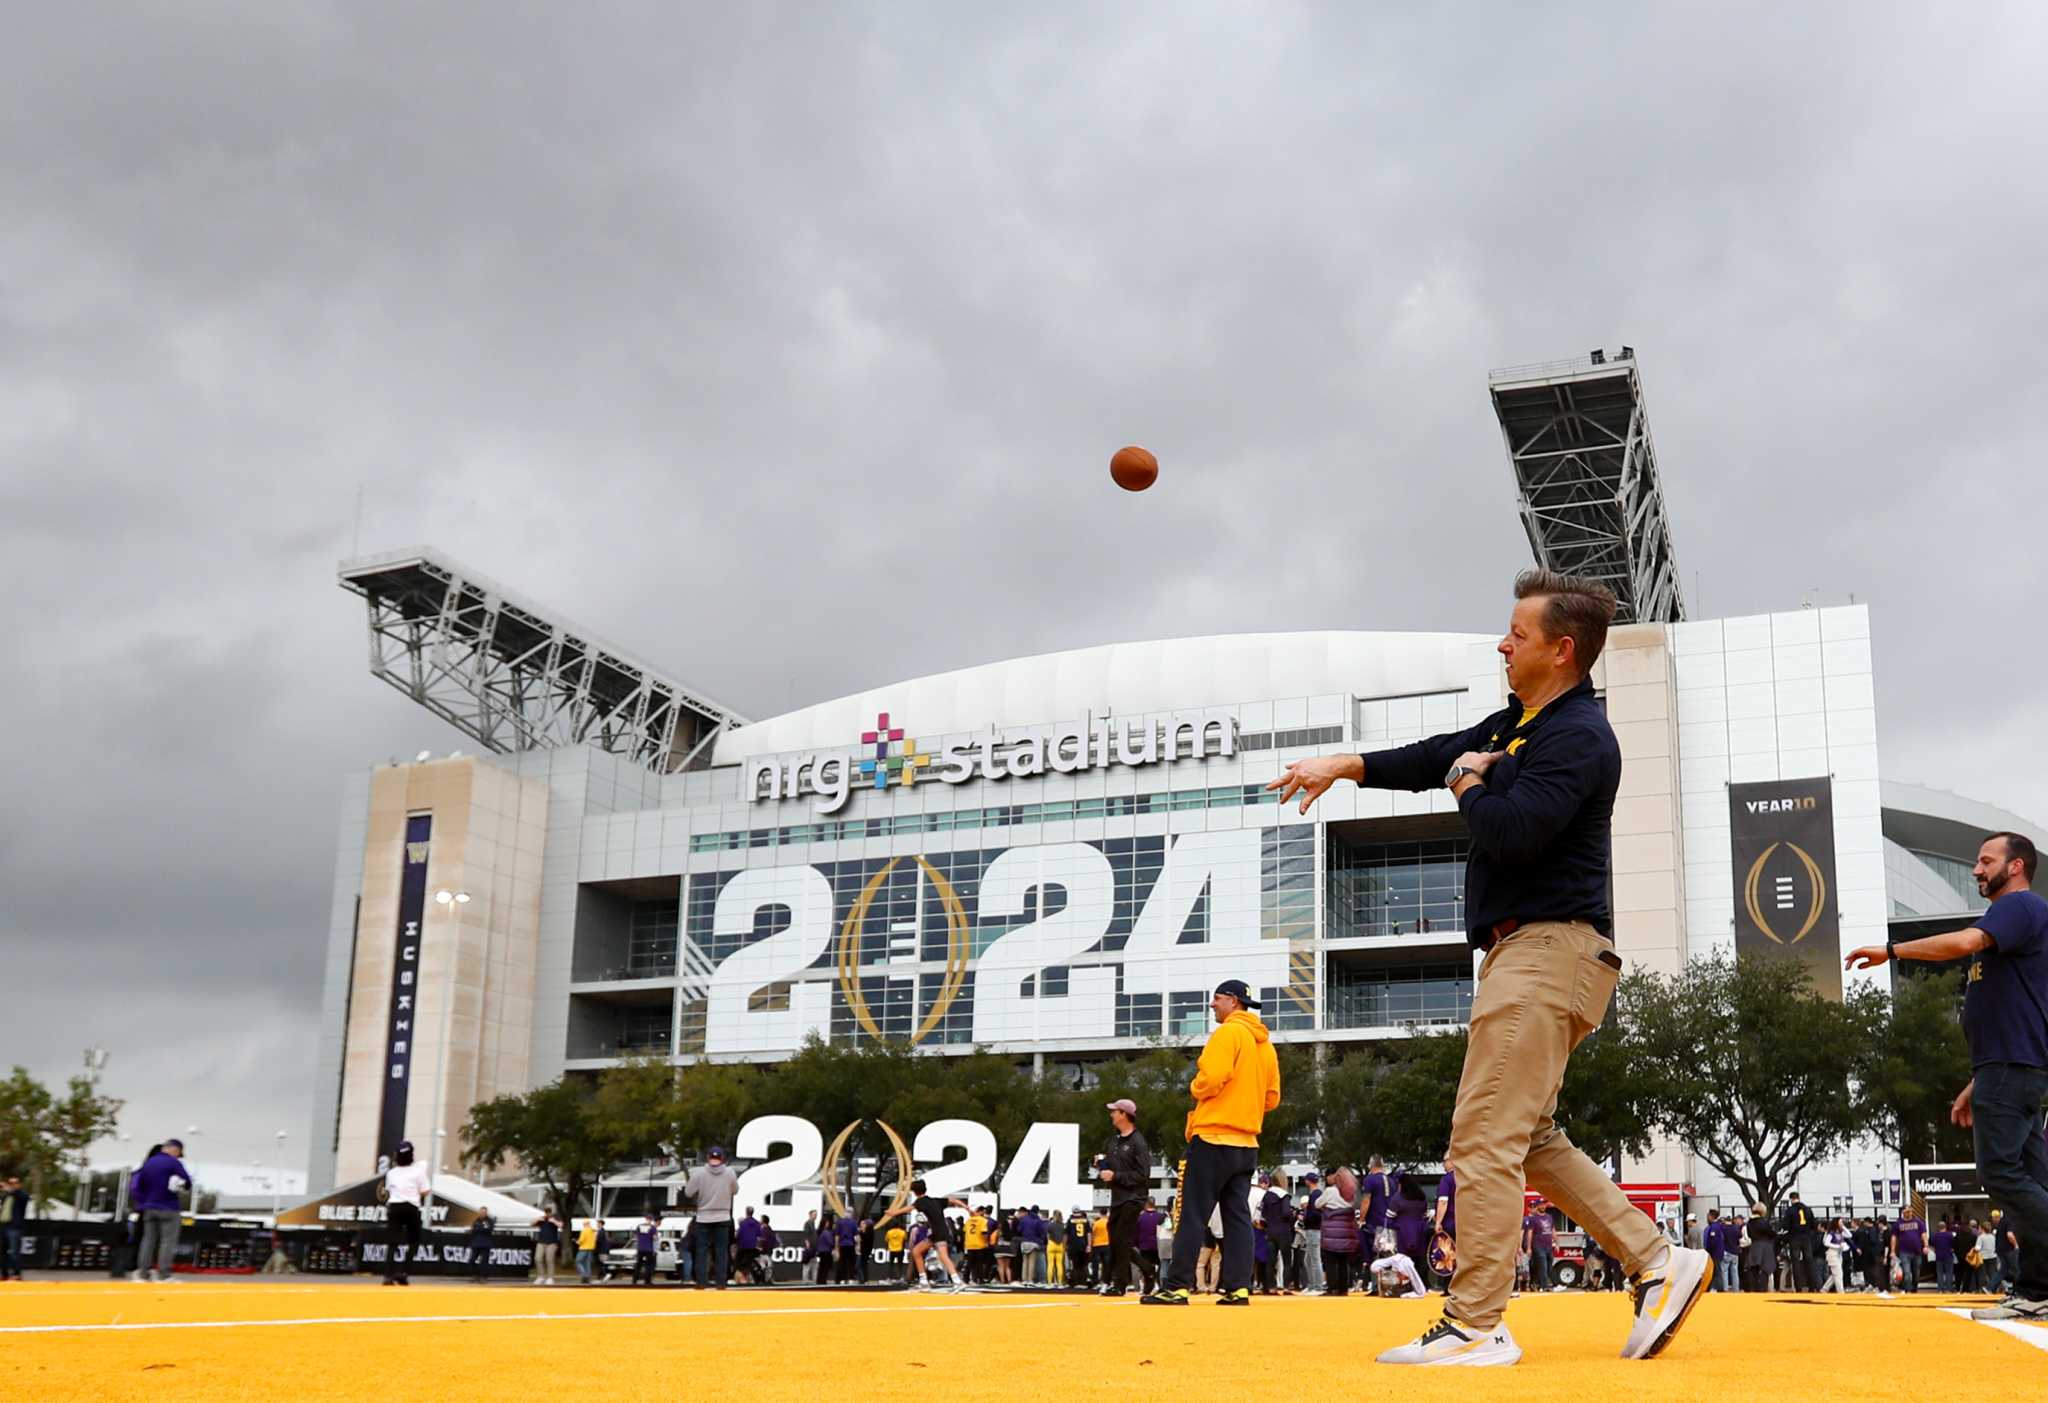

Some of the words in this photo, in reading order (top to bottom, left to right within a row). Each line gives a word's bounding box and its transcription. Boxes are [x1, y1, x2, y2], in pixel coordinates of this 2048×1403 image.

[748, 752, 851, 815] nrg
[939, 708, 1240, 785] stadium
[391, 921, 418, 1079] HUSKIES
[1915, 1179, 1952, 1192] Modelo
[319, 1205, 356, 1220] BLUE
[1076, 1223, 1084, 1237] 9
